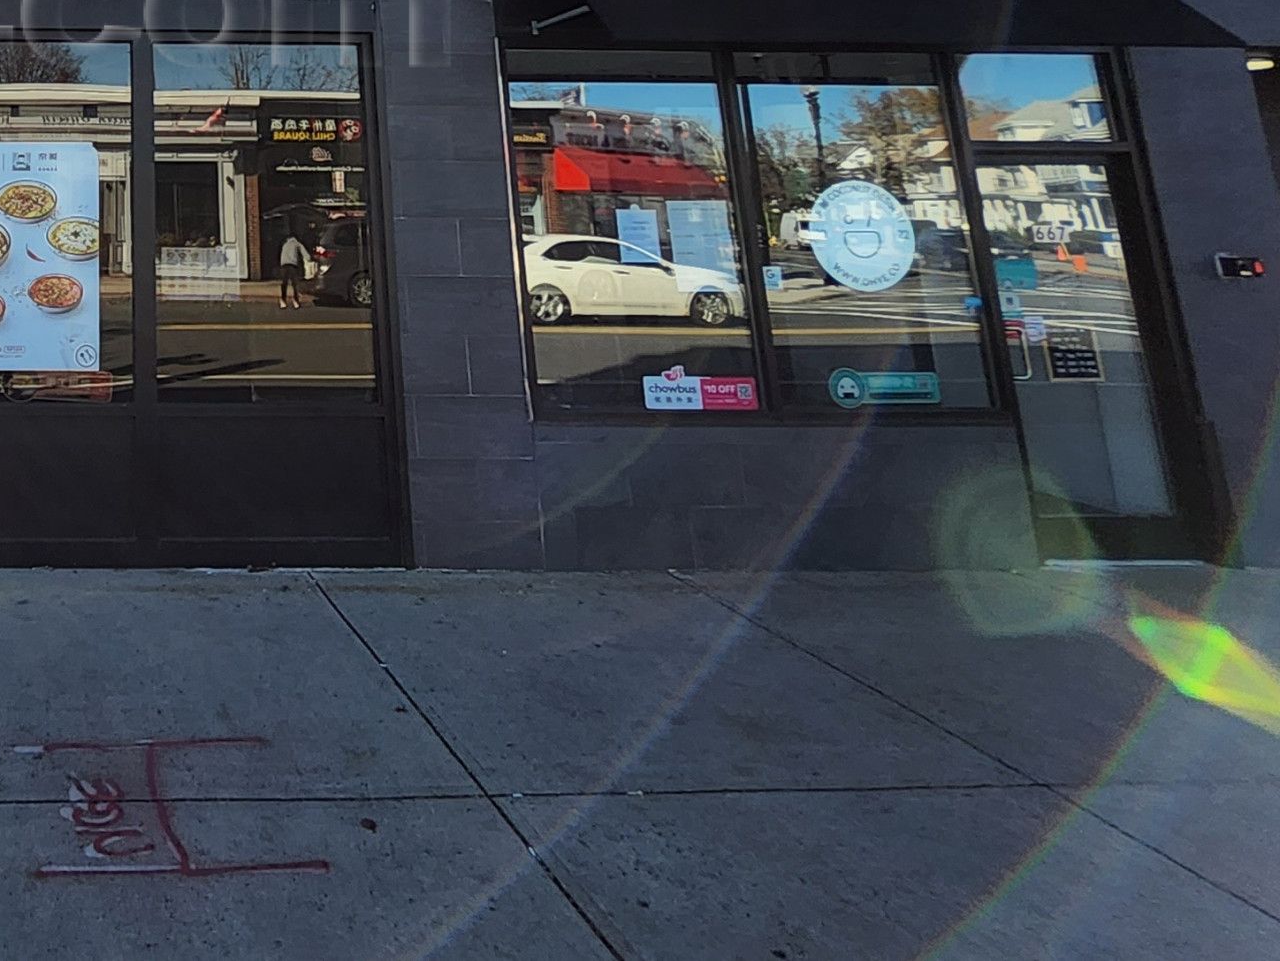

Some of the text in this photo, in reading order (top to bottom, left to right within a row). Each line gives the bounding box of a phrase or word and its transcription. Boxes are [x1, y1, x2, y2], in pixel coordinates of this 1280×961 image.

[1035, 225, 1066, 241] 667
[648, 383, 697, 394] chowbus
[719, 385, 736, 394] OFF
